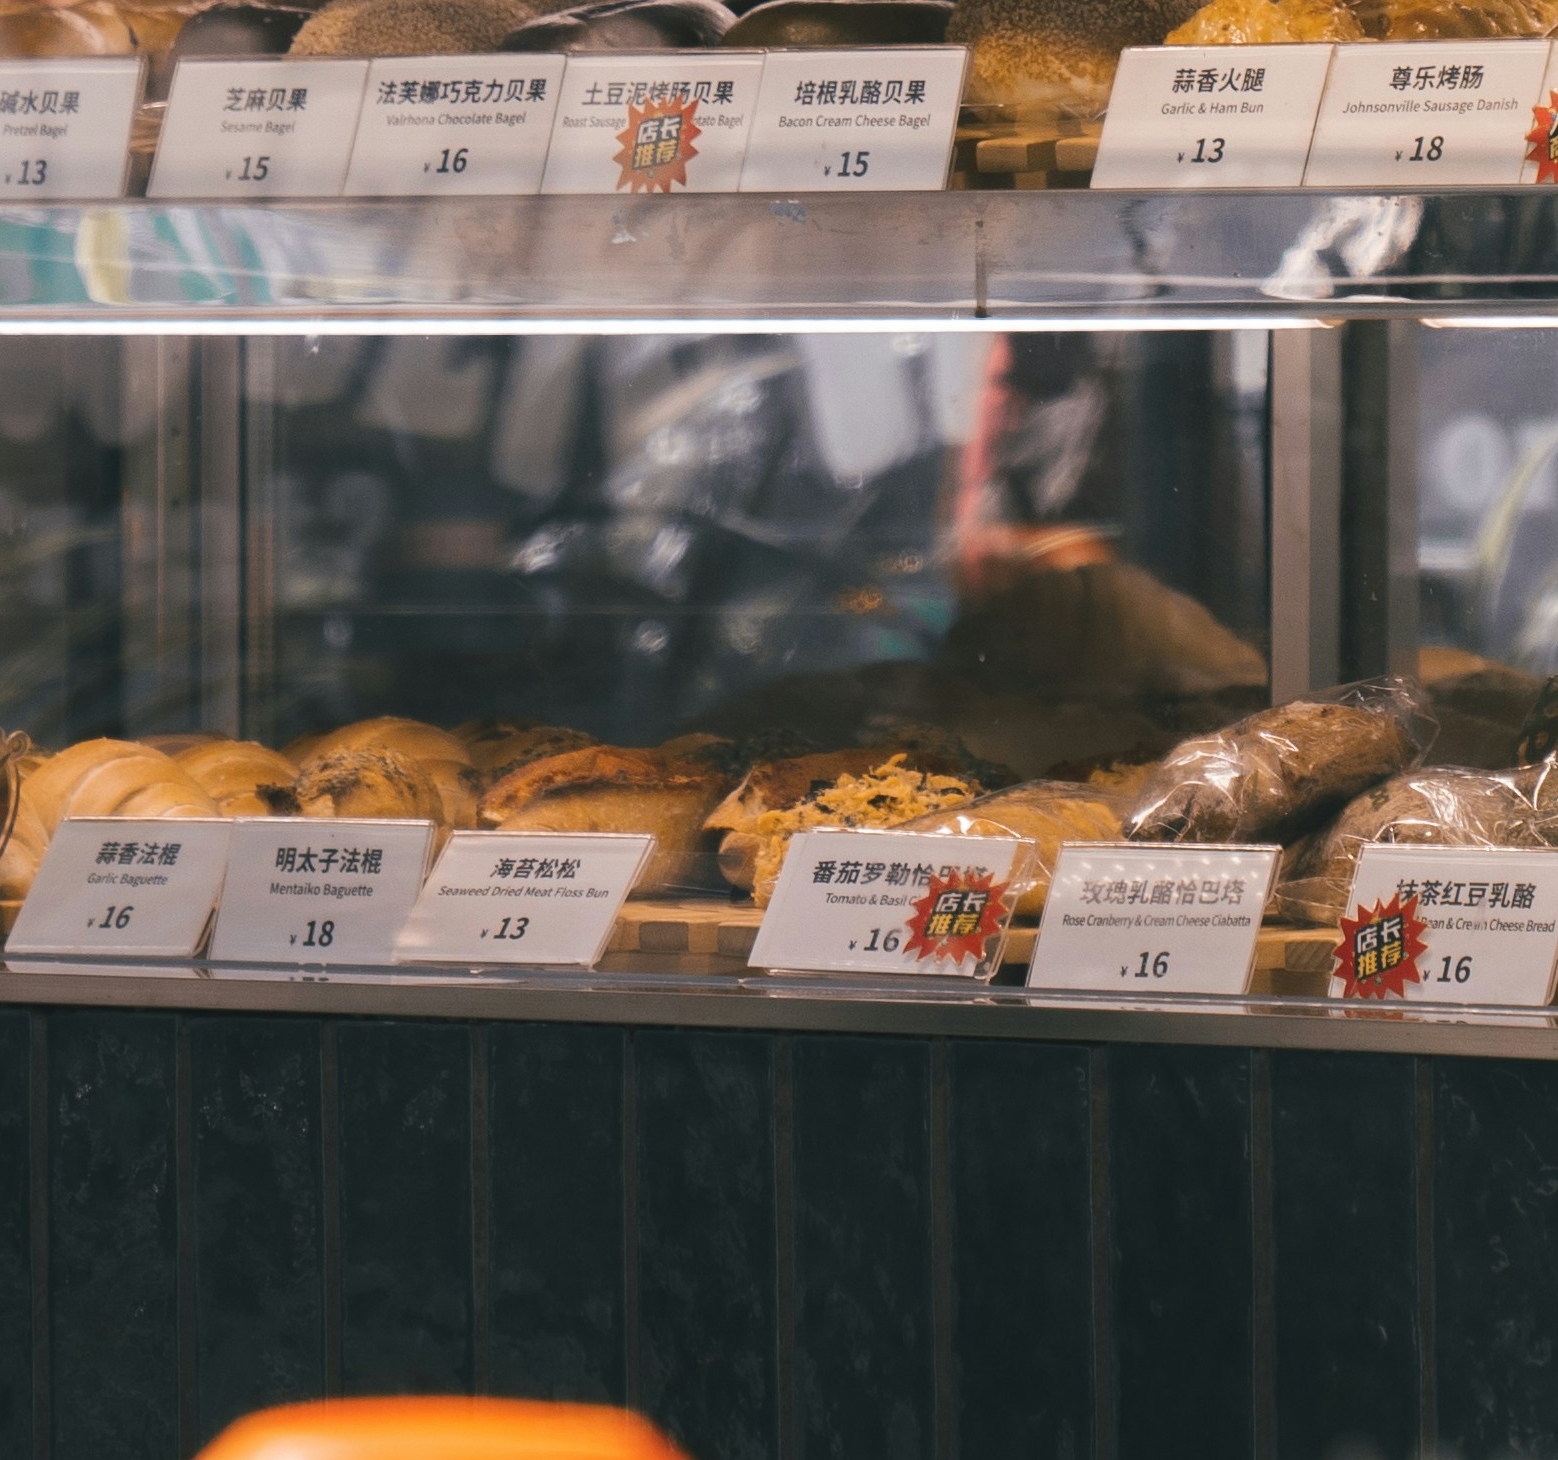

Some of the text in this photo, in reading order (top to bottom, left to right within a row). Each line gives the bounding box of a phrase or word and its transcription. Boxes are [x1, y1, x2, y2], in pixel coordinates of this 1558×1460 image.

[1172, 68, 1265, 93] 蒜香火腿
[1390, 65, 1484, 90] 尊乐烤肠
[223, 88, 307, 111] 芝麻贝果
[377, 79, 547, 104] 法芙娜巧克力贝果
[582, 81, 734, 105] 土豆泥烤肠贝果
[795, 80, 926, 105] 培根乳酪贝果
[1162, 103, 1263, 115] Garlic & Ham Bun
[1343, 98, 1518, 113] Johnsonville Sausage Danish
[221, 121, 295, 134] Sesame Bagel
[387, 112, 526, 126] Valrhona Chocolate Bagel
[563, 115, 743, 129] Roast Sausage Bagel
[779, 114, 930, 129] Bacon Cream Cheese Bagel
[3, 124, 67, 138] Pretzel Bagel
[638, 117, 680, 143] 店长
[634, 141, 677, 168] 推荐
[96, 842, 181, 865] 蒜香法棍
[276, 847, 383, 874] 明太子法棍
[490, 858, 581, 879] 海苔松松
[87, 873, 168, 887] Garlic Baguette
[270, 883, 373, 899] Mentaiko Baguette
[438, 886, 609, 898] Seaweed Dried Meat Floss Bun
[826, 893, 867, 905] Tomato
[869, 895, 876, 905] &
[880, 895, 906, 906] Basil
[1080, 879, 1247, 905] 玫瑰乳酪恰巴塔
[1397, 880, 1537, 909] 抹茶红豆乳酪
[936, 892, 987, 912] 店长
[928, 914, 978, 935] 推荐
[1063, 914, 1251, 929] Rose Cranberry & Cream Cheese Ciabatta
[1445, 918, 1556, 933] & Cheese Bread
[1357, 917, 1401, 953] 店长
[1358, 941, 1401, 979] 推荐
